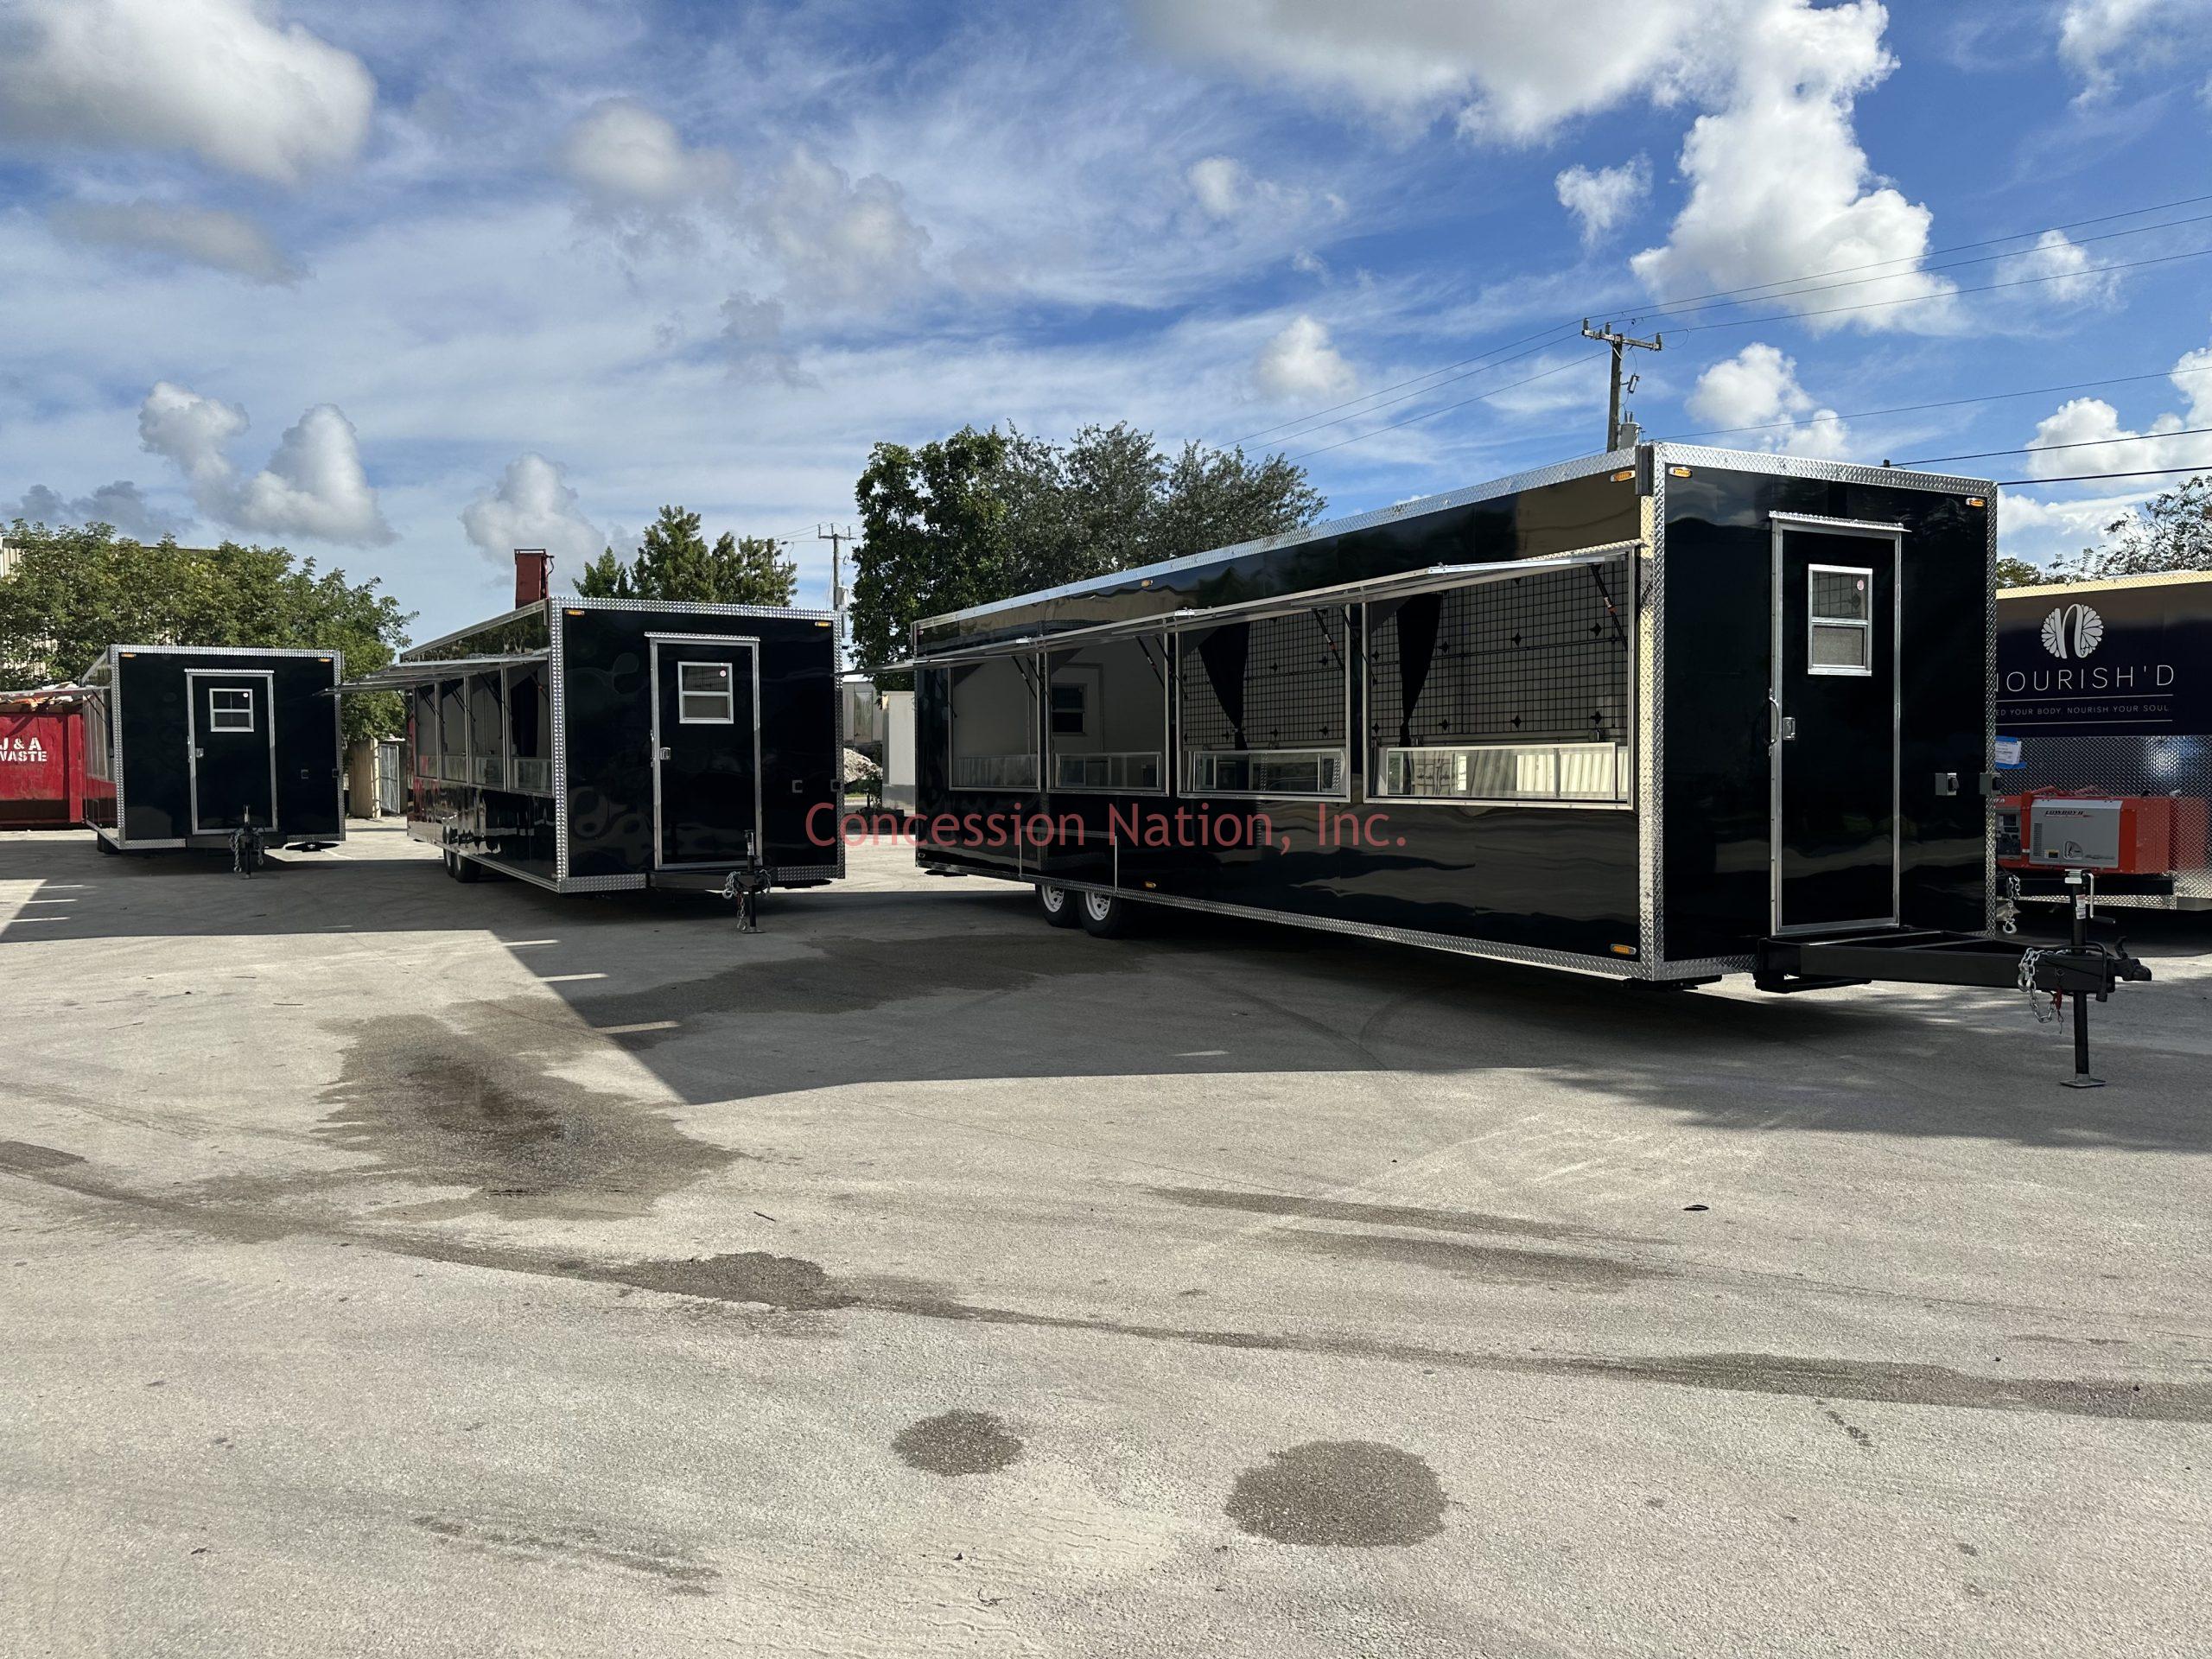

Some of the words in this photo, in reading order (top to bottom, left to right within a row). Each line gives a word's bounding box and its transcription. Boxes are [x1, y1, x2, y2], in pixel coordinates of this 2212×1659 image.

[1995, 664, 2174, 692] OURISH'D
[0, 737, 9, 751] J
[13, 738, 25, 750] &
[29, 737, 42, 751] A
